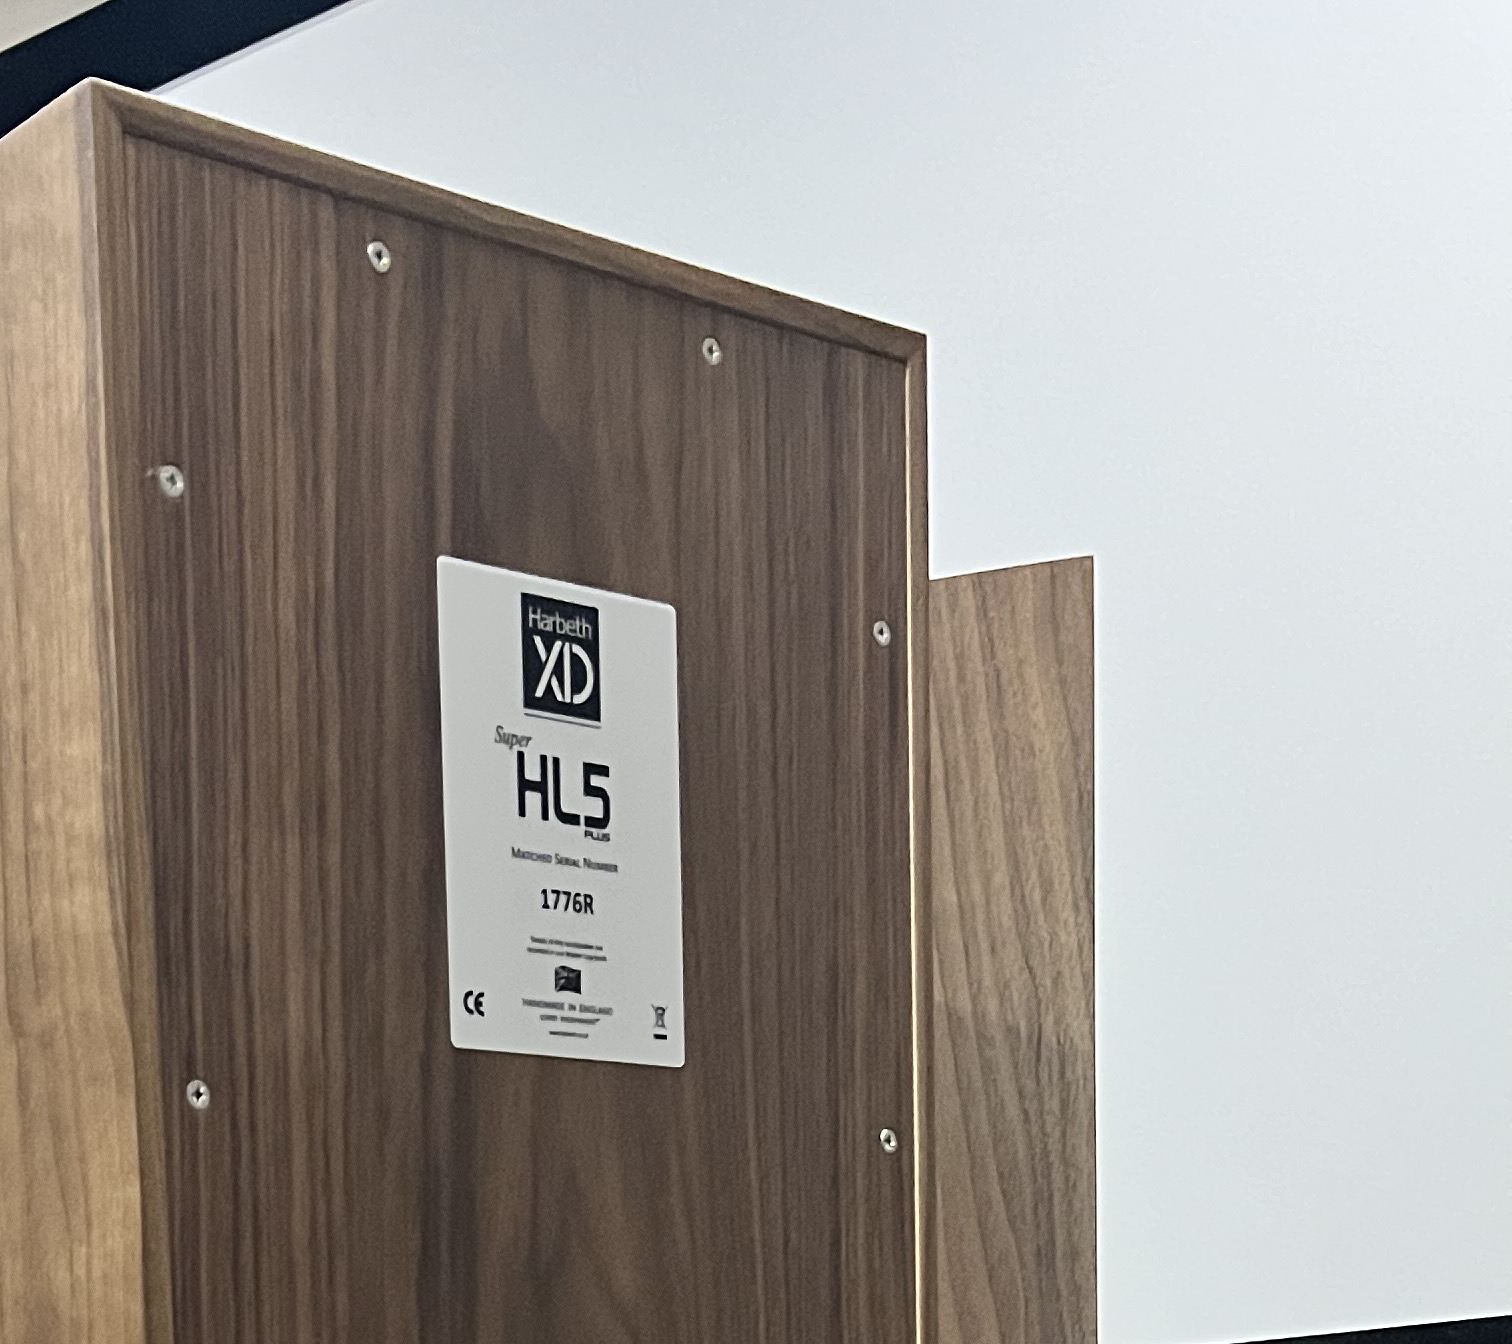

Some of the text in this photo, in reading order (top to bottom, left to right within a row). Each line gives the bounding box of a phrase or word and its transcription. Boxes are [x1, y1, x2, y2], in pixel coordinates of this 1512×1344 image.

[528, 605, 592, 641] Harbeth
[533, 634, 594, 705] XD
[494, 725, 532, 750] Super
[516, 750, 611, 830] HL5
[541, 888, 594, 915] 1776R
